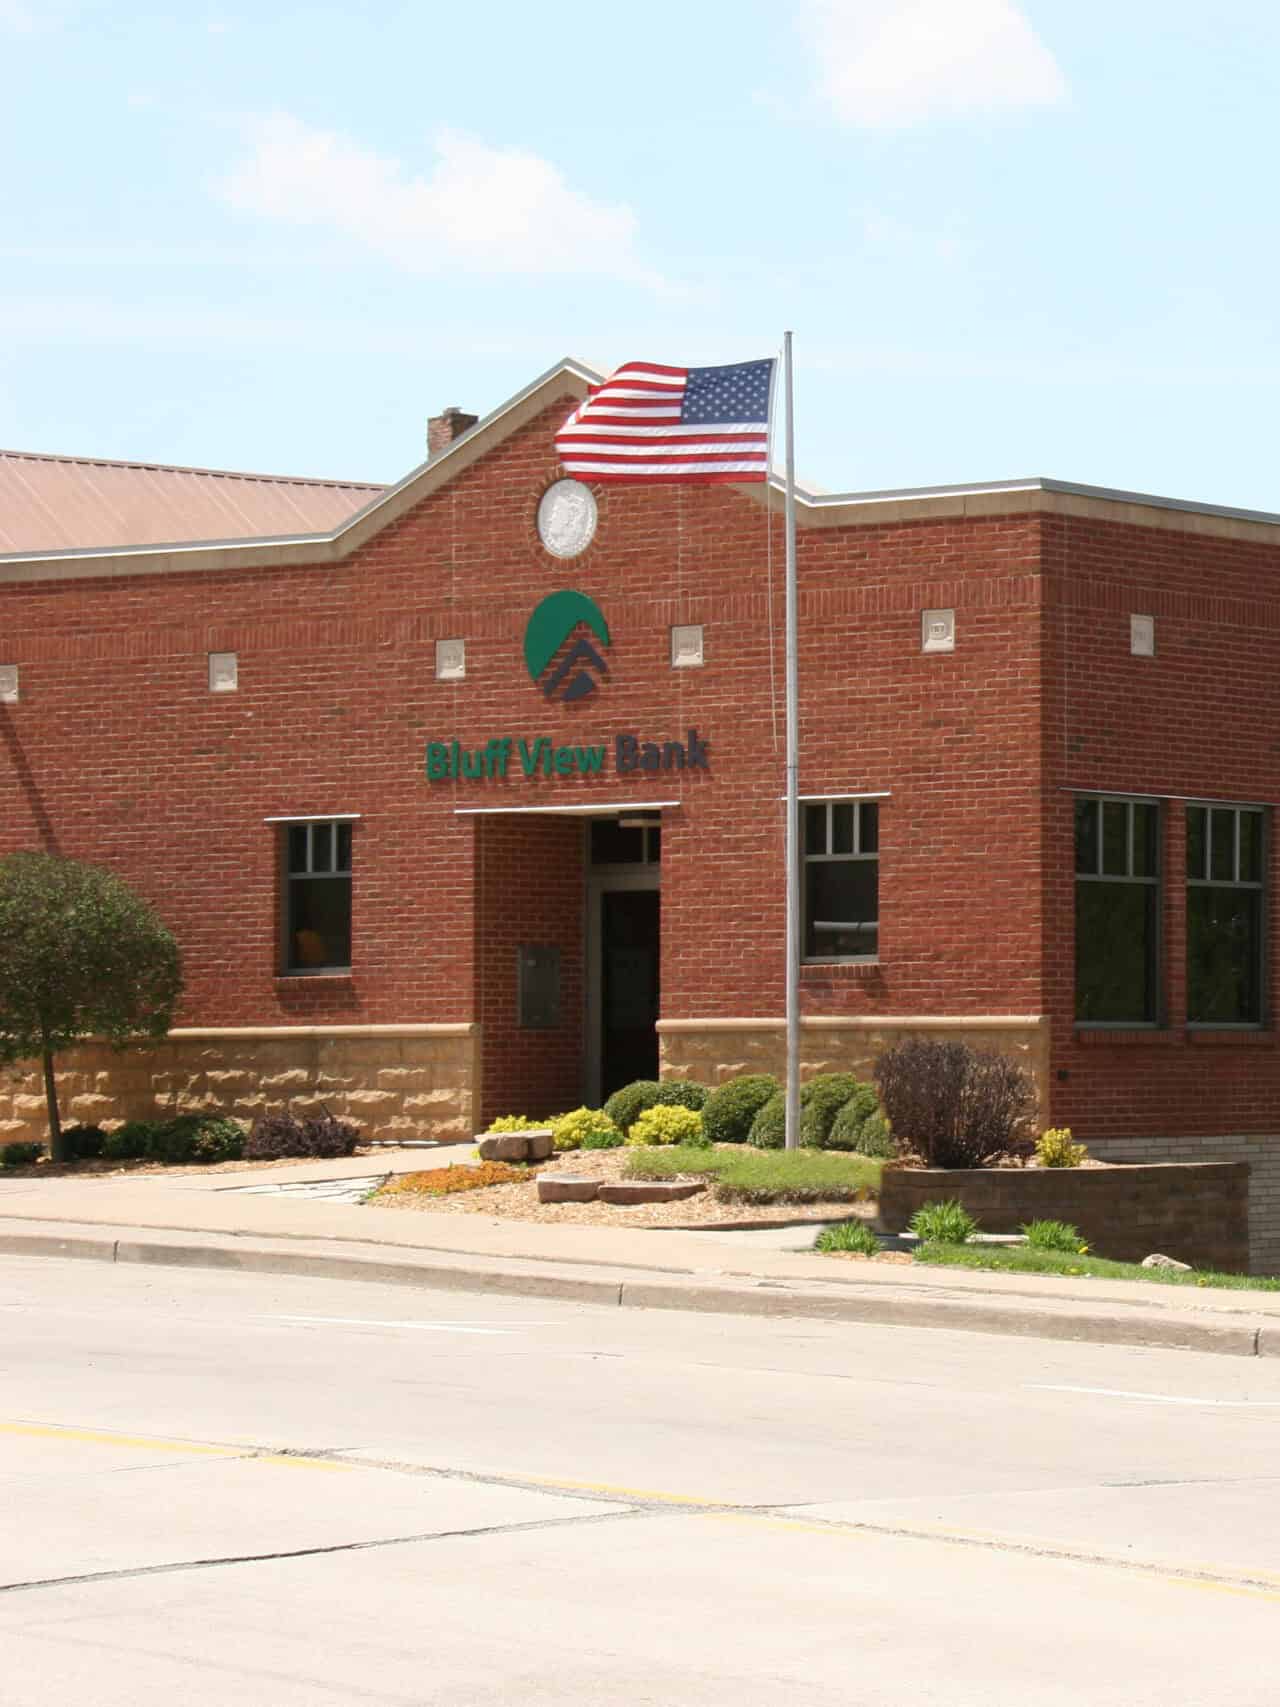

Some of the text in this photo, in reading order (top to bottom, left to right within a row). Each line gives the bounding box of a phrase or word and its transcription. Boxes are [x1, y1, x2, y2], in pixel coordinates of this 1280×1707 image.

[425, 728, 710, 781] Bluff View Bank
